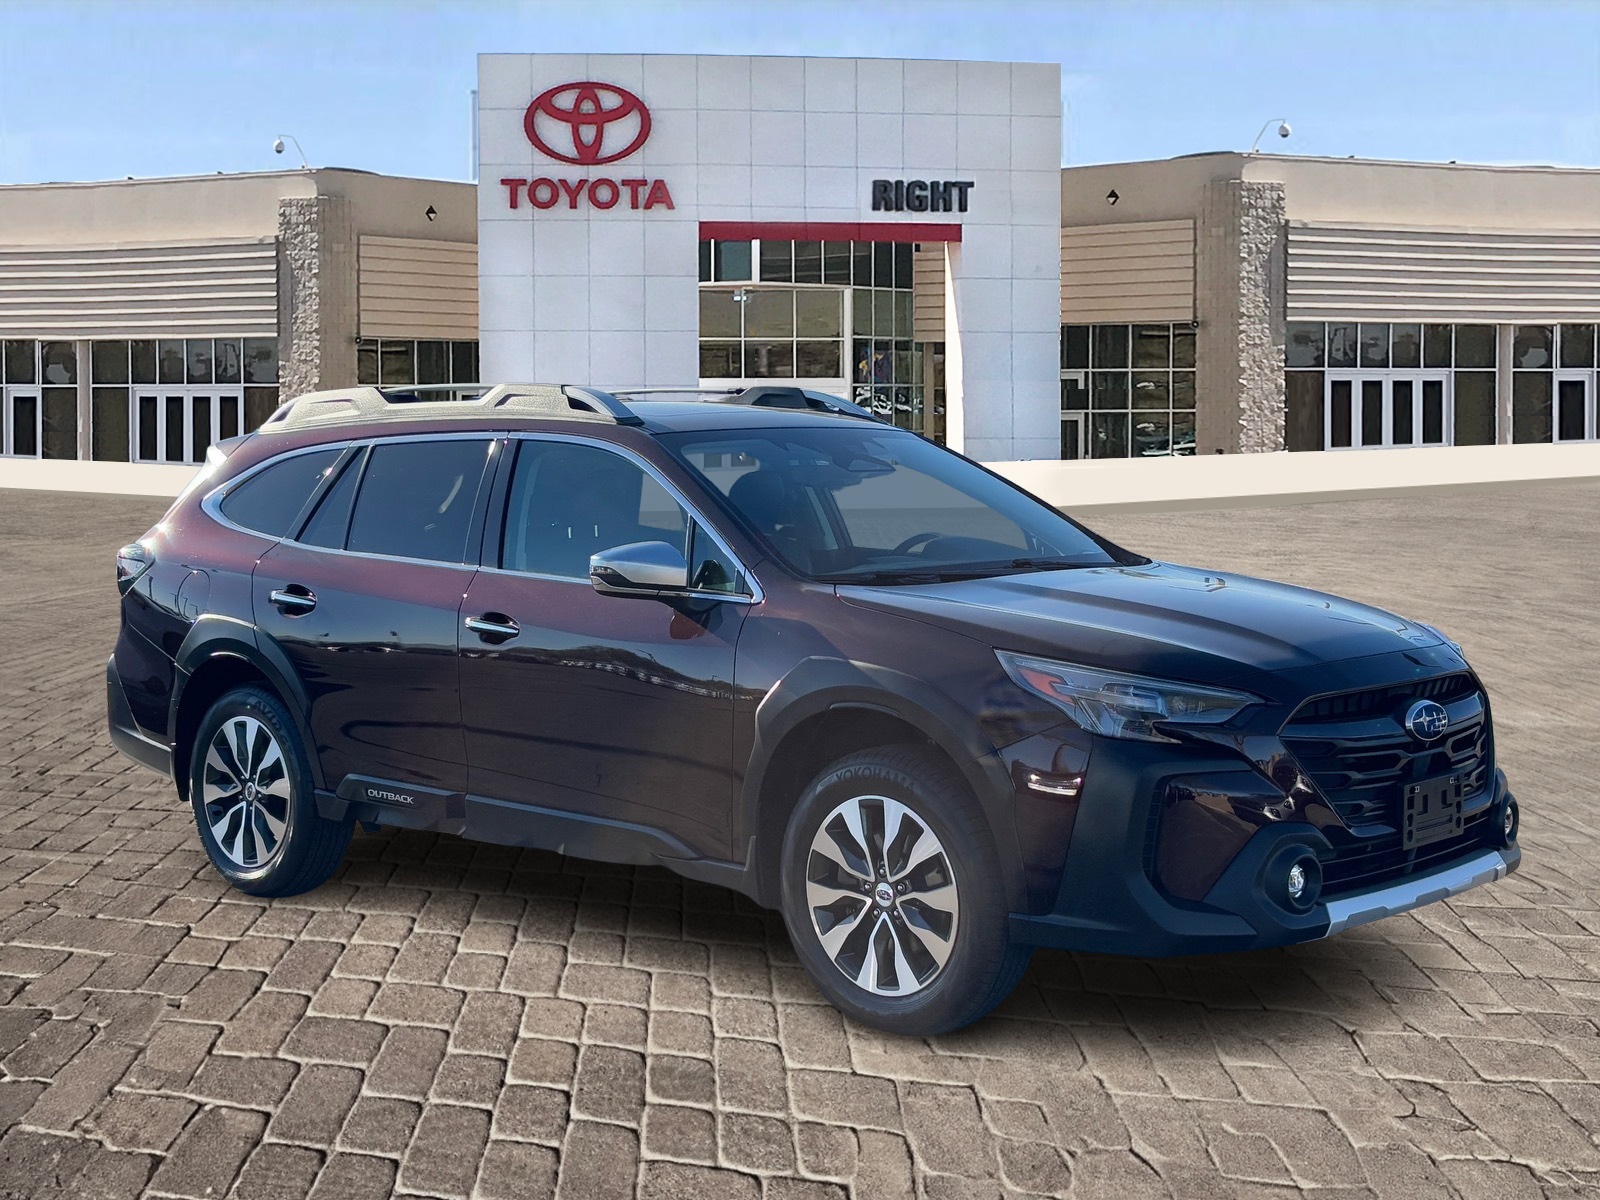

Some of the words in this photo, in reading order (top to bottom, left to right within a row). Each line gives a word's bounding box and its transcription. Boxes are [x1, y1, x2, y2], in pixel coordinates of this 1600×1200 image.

[500, 177, 676, 210] TOYOTA
[872, 179, 975, 212] RIGHT
[835, 766, 915, 792] YOKOHAMA
[367, 788, 415, 804] OUTBACK
